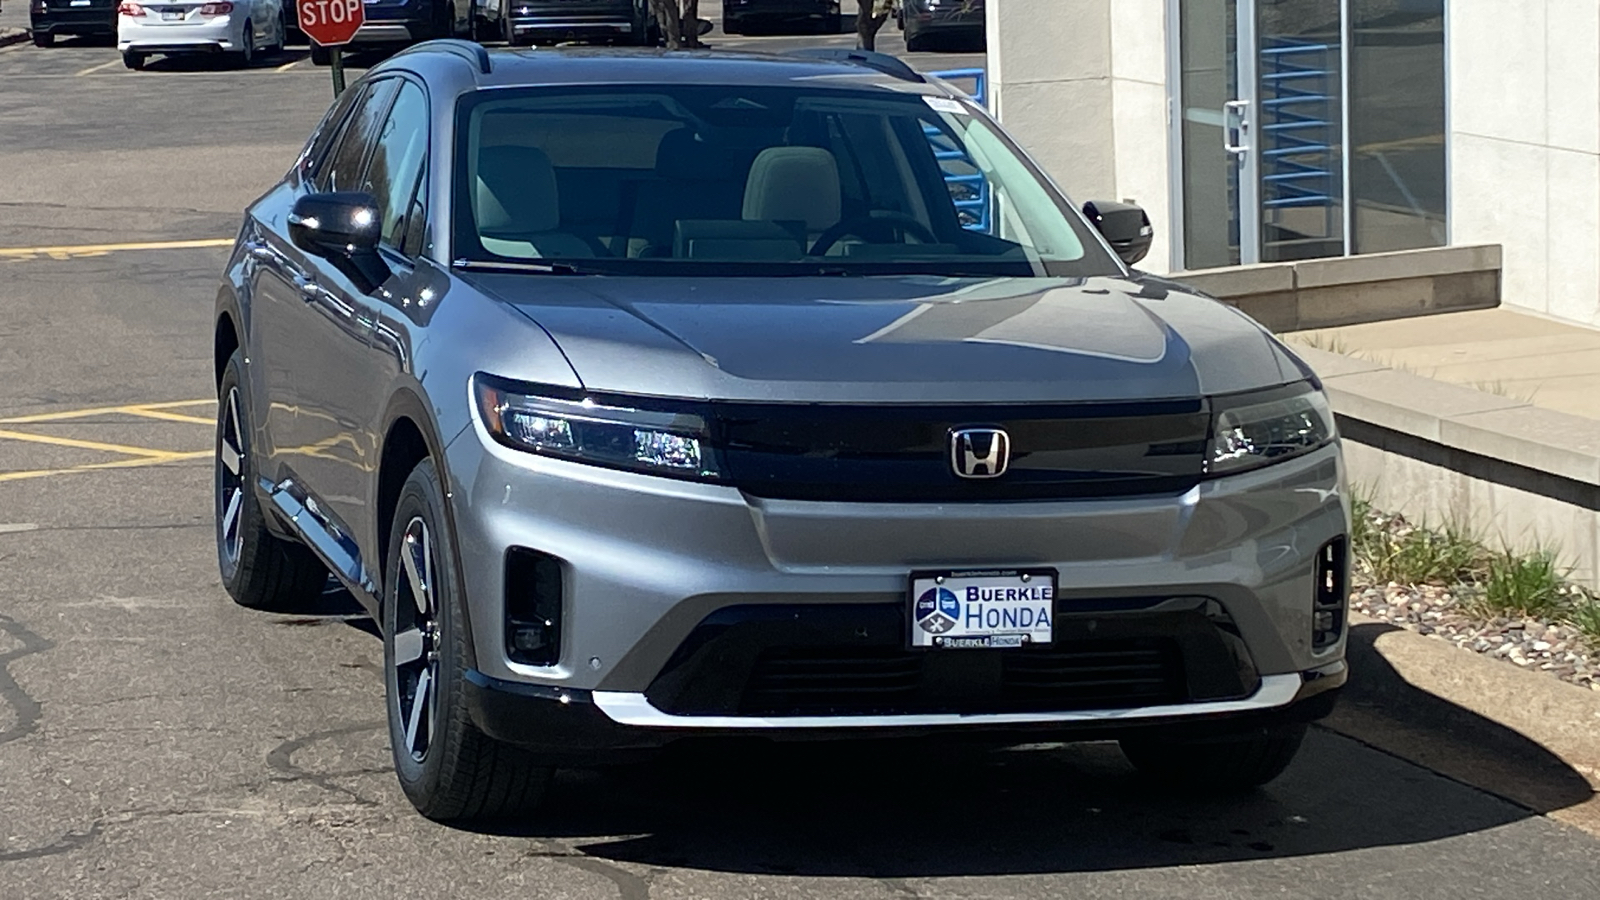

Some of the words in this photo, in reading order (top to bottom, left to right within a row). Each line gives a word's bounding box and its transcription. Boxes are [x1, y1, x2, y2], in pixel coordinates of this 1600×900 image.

[302, 0, 359, 26] STOP
[966, 586, 1052, 601] BUERKLE
[965, 603, 1051, 629] HONDA
